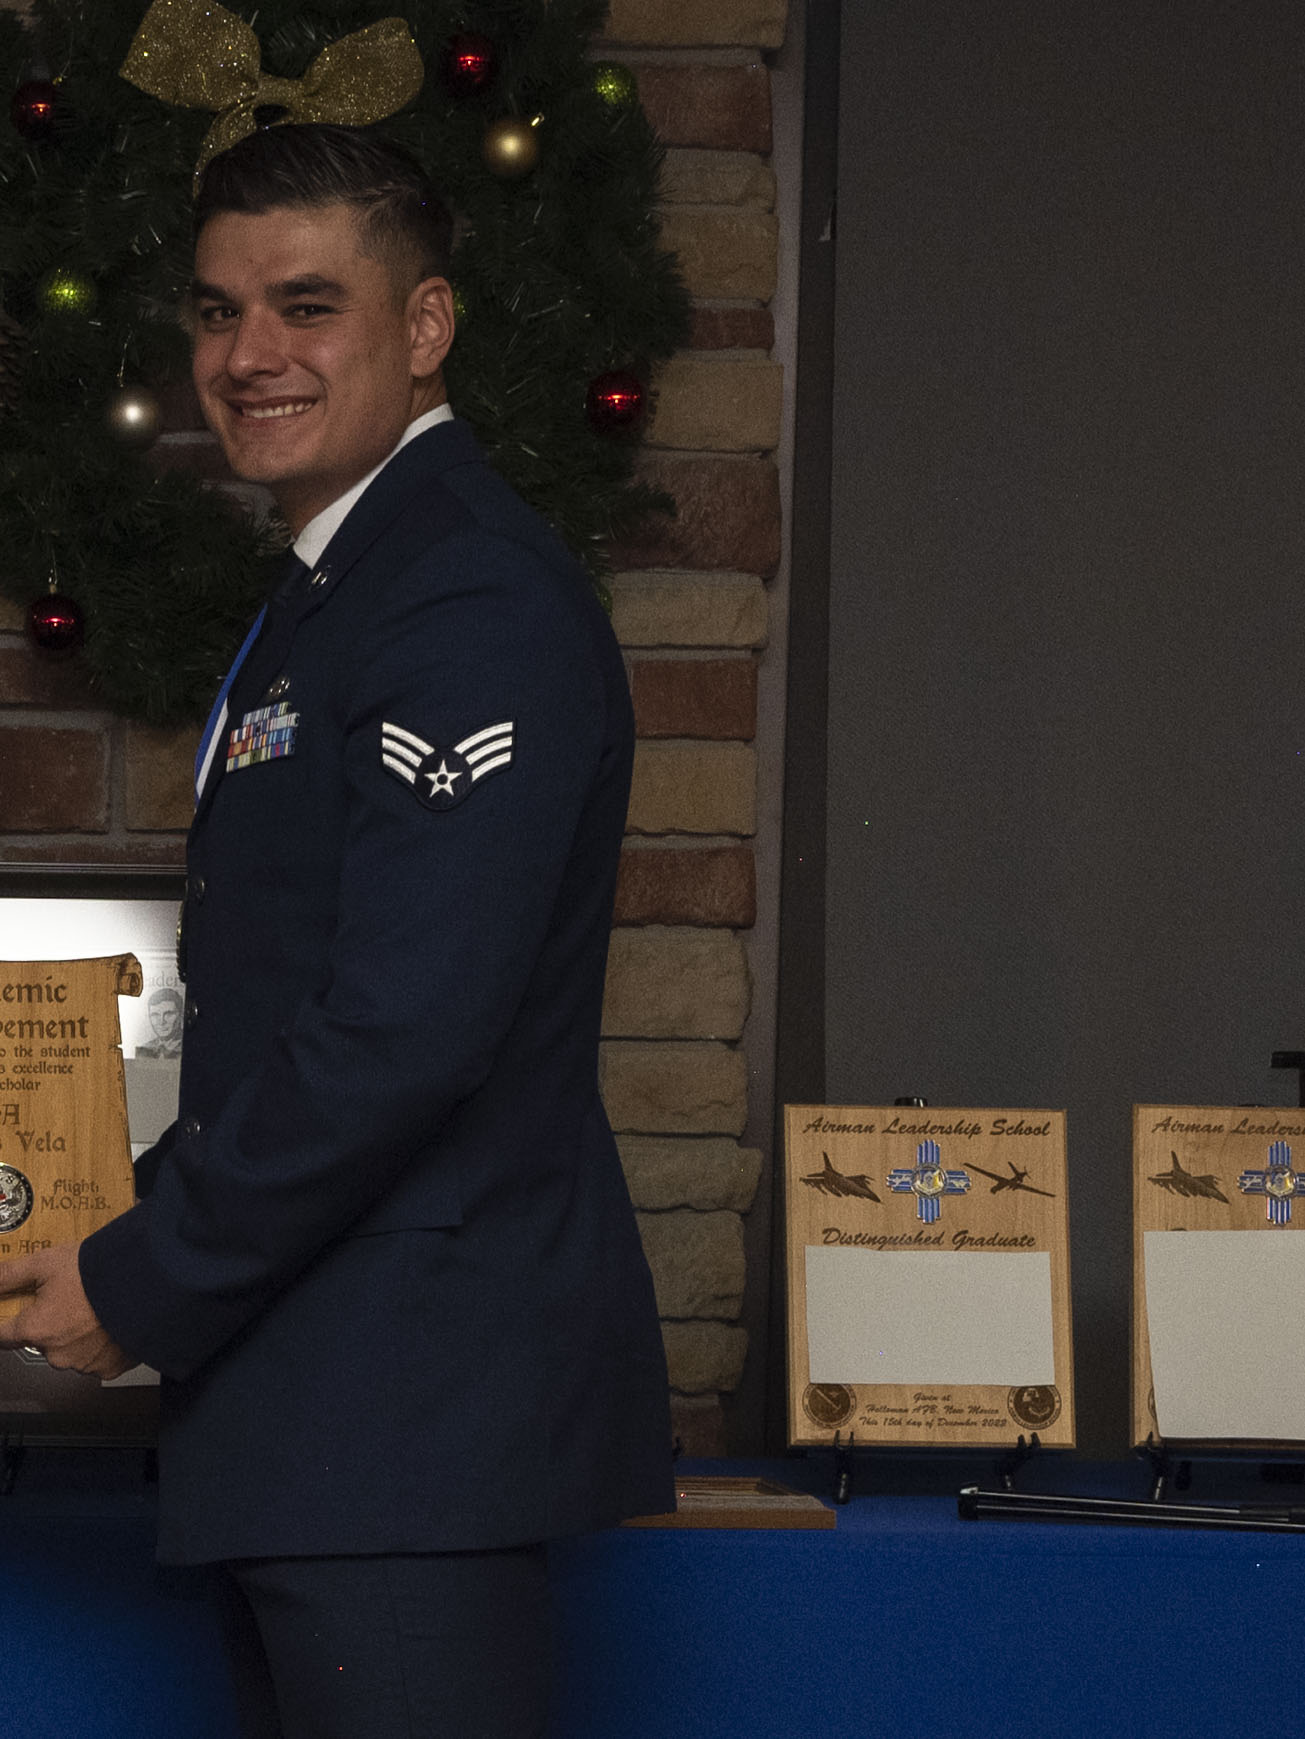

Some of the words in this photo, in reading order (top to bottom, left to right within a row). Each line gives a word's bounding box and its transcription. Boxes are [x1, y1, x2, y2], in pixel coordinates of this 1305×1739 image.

[14, 1045, 33, 1058] the
[40, 1045, 90, 1058] student
[12, 1062, 74, 1074] excellence
[803, 1117, 876, 1135] Airman
[881, 1118, 982, 1139] Leadership
[990, 1119, 1051, 1137] School
[1152, 1116, 1225, 1134] Airman
[1230, 1117, 1305, 1136] Leaders
[15, 1130, 66, 1152] Vela
[40, 1195, 111, 1213] M.O.A.B.
[822, 1227, 944, 1250] Distinguished
[951, 1230, 1036, 1250] Graduate
[913, 1392, 938, 1403] Given
[943, 1405, 964, 1414] New
[858, 1416, 878, 1426] This
[906, 1418, 922, 1428] day
[925, 1418, 934, 1429] of
[937, 1417, 977, 1427] December
